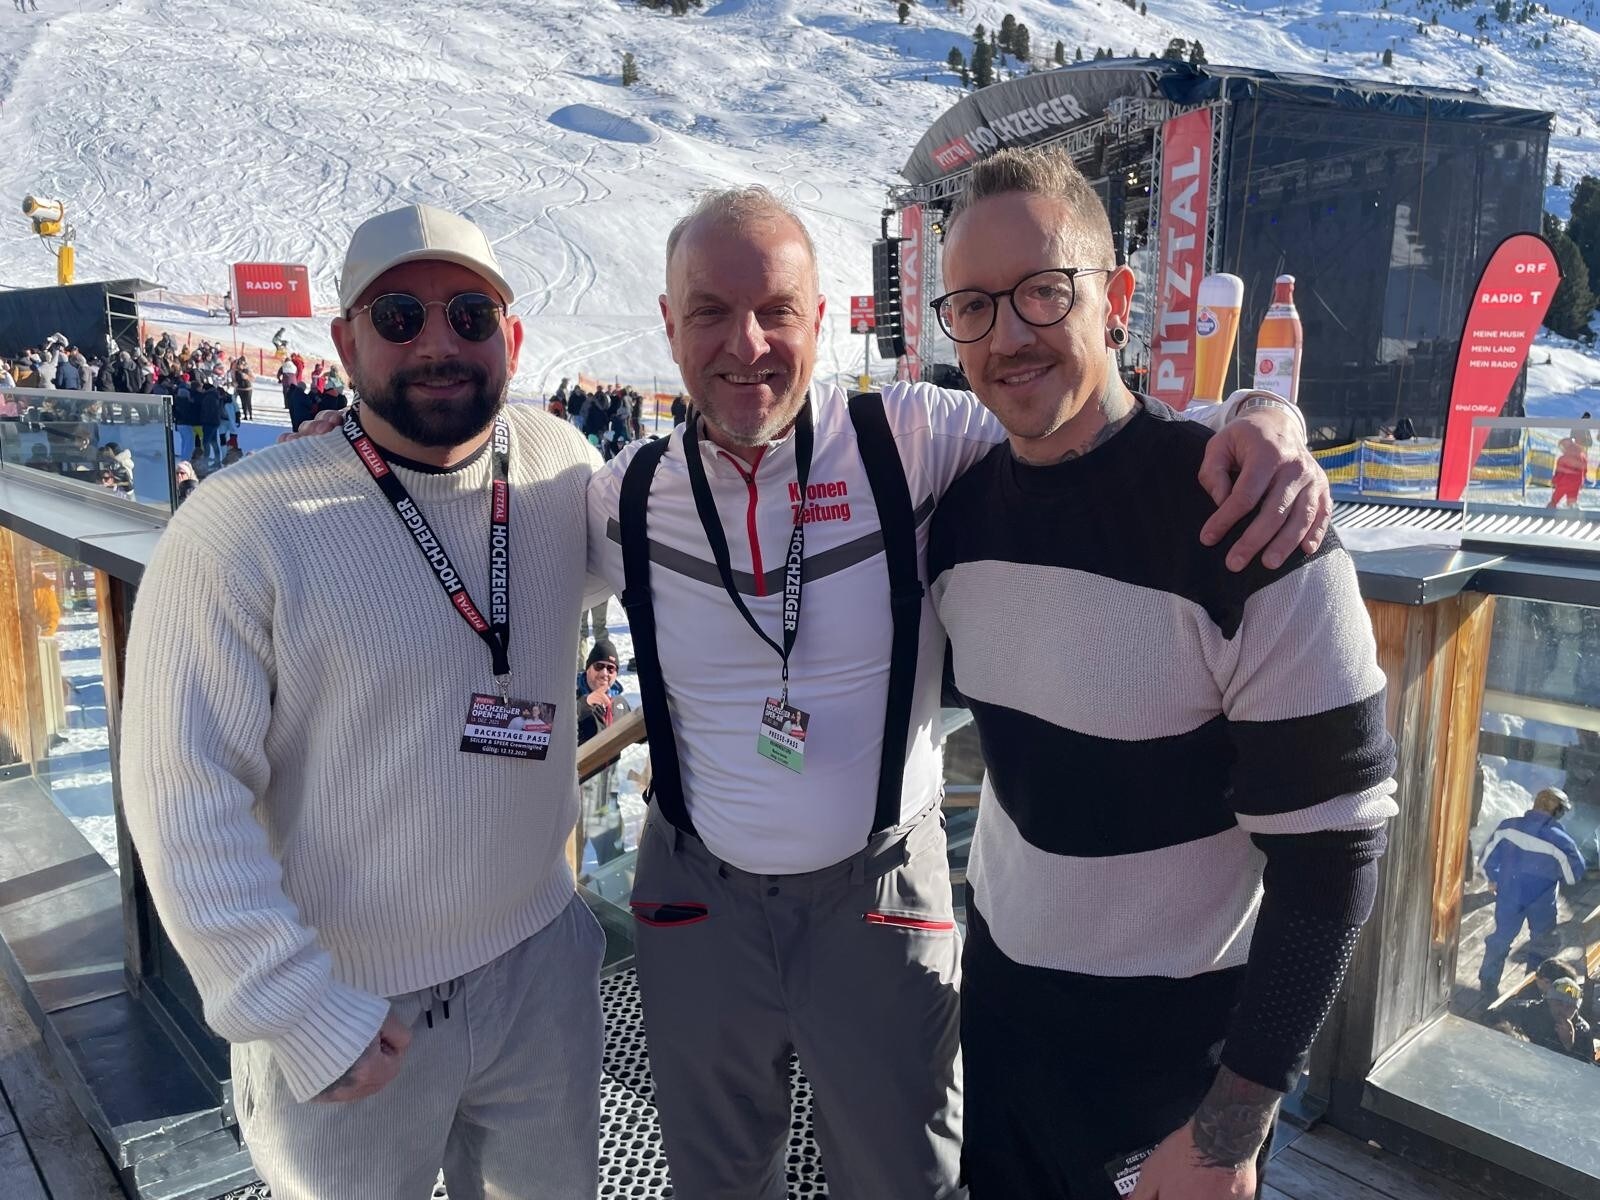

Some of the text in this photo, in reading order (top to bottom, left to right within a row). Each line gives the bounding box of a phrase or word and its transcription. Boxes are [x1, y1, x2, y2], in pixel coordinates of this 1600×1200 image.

[965, 94, 1089, 153] HOCHZEIGER
[1157, 146, 1200, 391] PITZTAL
[1515, 263, 1547, 273] ORF
[246, 280, 298, 292] RADIO T
[1482, 291, 1542, 304] RADIO T
[1471, 345, 1491, 353] MEIN
[1469, 360, 1518, 368] MEIN RADIO
[359, 441, 384, 473] PITZTAL
[788, 480, 847, 502] Konen
[791, 502, 850, 525] Zeitung
[396, 498, 483, 629] PITZTAL HOCHZEIGER
[492, 483, 507, 624] PITZTAL HOCHZEIGER
[785, 529, 803, 631] HOCHZEIGER
[472, 710, 508, 720] OPEN-AIR
[474, 729, 547, 743] BACKSTAGE PASS
[769, 730, 799, 749] PRESSE-PASS
